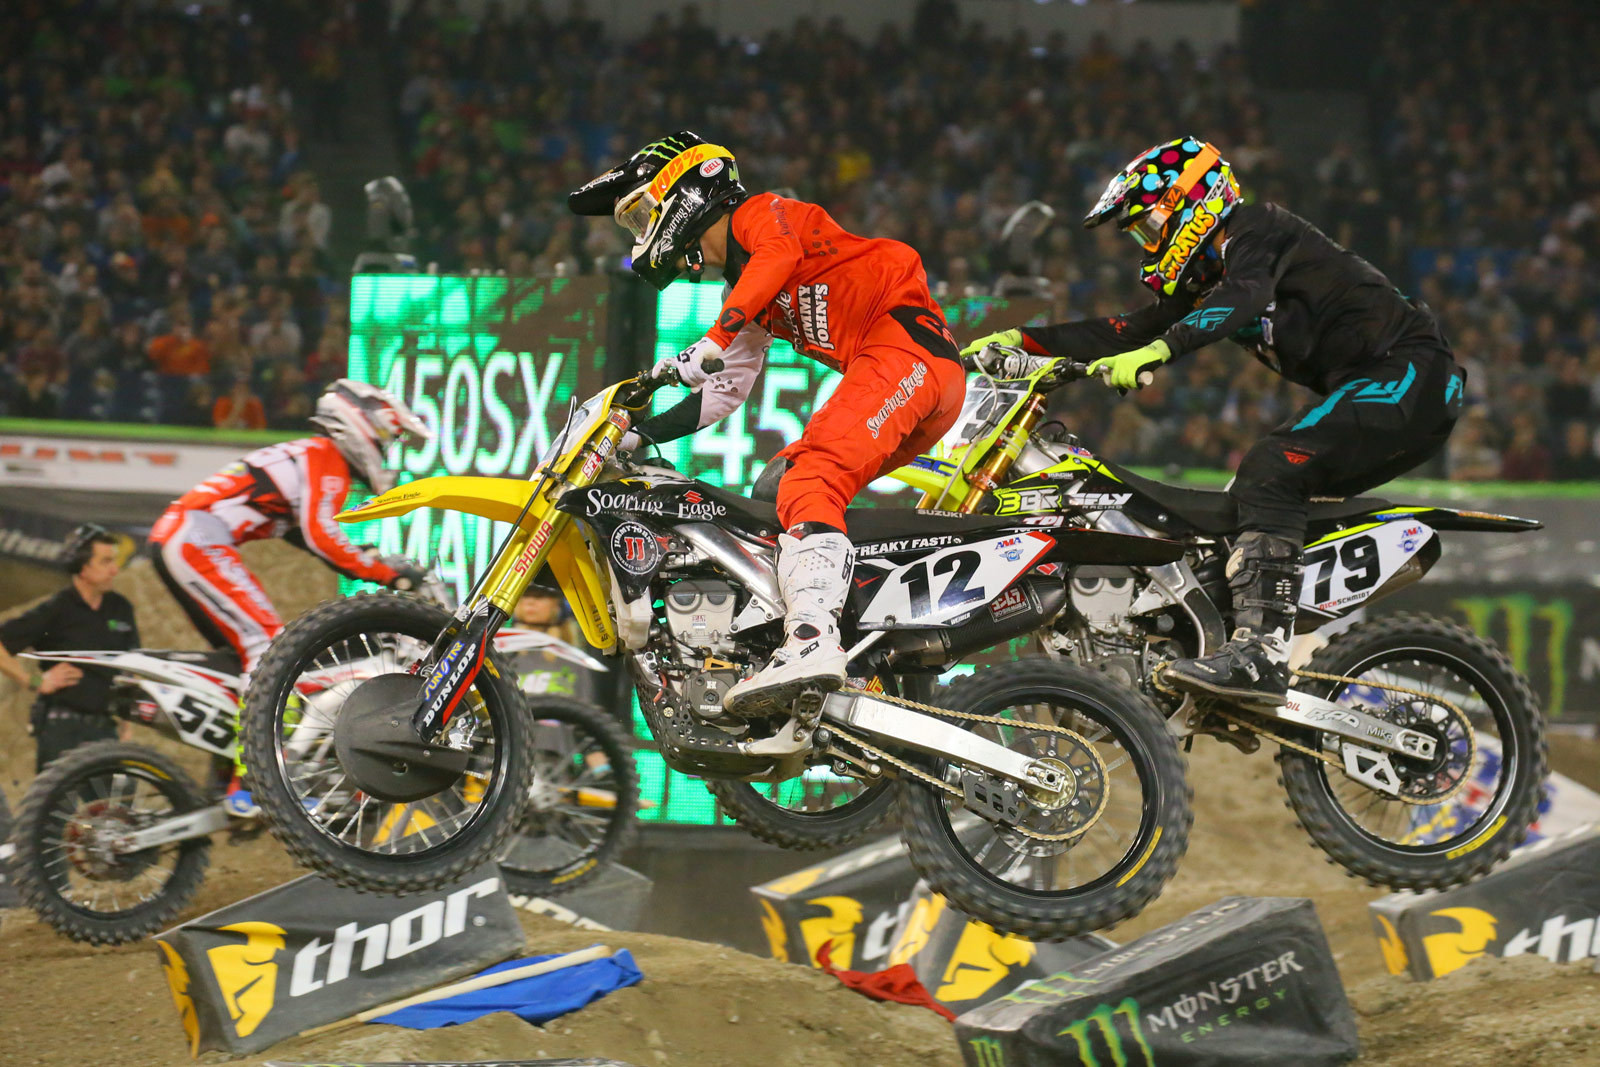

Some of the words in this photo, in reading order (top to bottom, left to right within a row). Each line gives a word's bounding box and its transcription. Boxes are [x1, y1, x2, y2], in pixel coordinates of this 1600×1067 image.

[703, 159, 720, 175] BELL
[680, 187, 702, 215] Eale
[798, 284, 819, 347] JIMMY
[815, 283, 836, 350] JOHN'S
[866, 388, 906, 438] Soaring
[899, 361, 928, 402] Eagle
[677, 500, 727, 521] Eagle
[918, 508, 963, 519] SUZUKI
[514, 520, 554, 578] SHOWA
[624, 536, 645, 561] JJ
[854, 540, 909, 557] FREAKY
[911, 535, 952, 549] FAST!
[995, 537, 1022, 550] AMA
[1401, 526, 1423, 538] AMA
[900, 550, 985, 620] 12
[1303, 535, 1381, 605] 79
[422, 643, 478, 728] DUNLOP
[173, 695, 236, 750] 55
[1285, 701, 1300, 712] OIL
[1366, 724, 1393, 743] Mika
[289, 876, 501, 998] thor
[1180, 987, 1287, 1044] ENERGY
